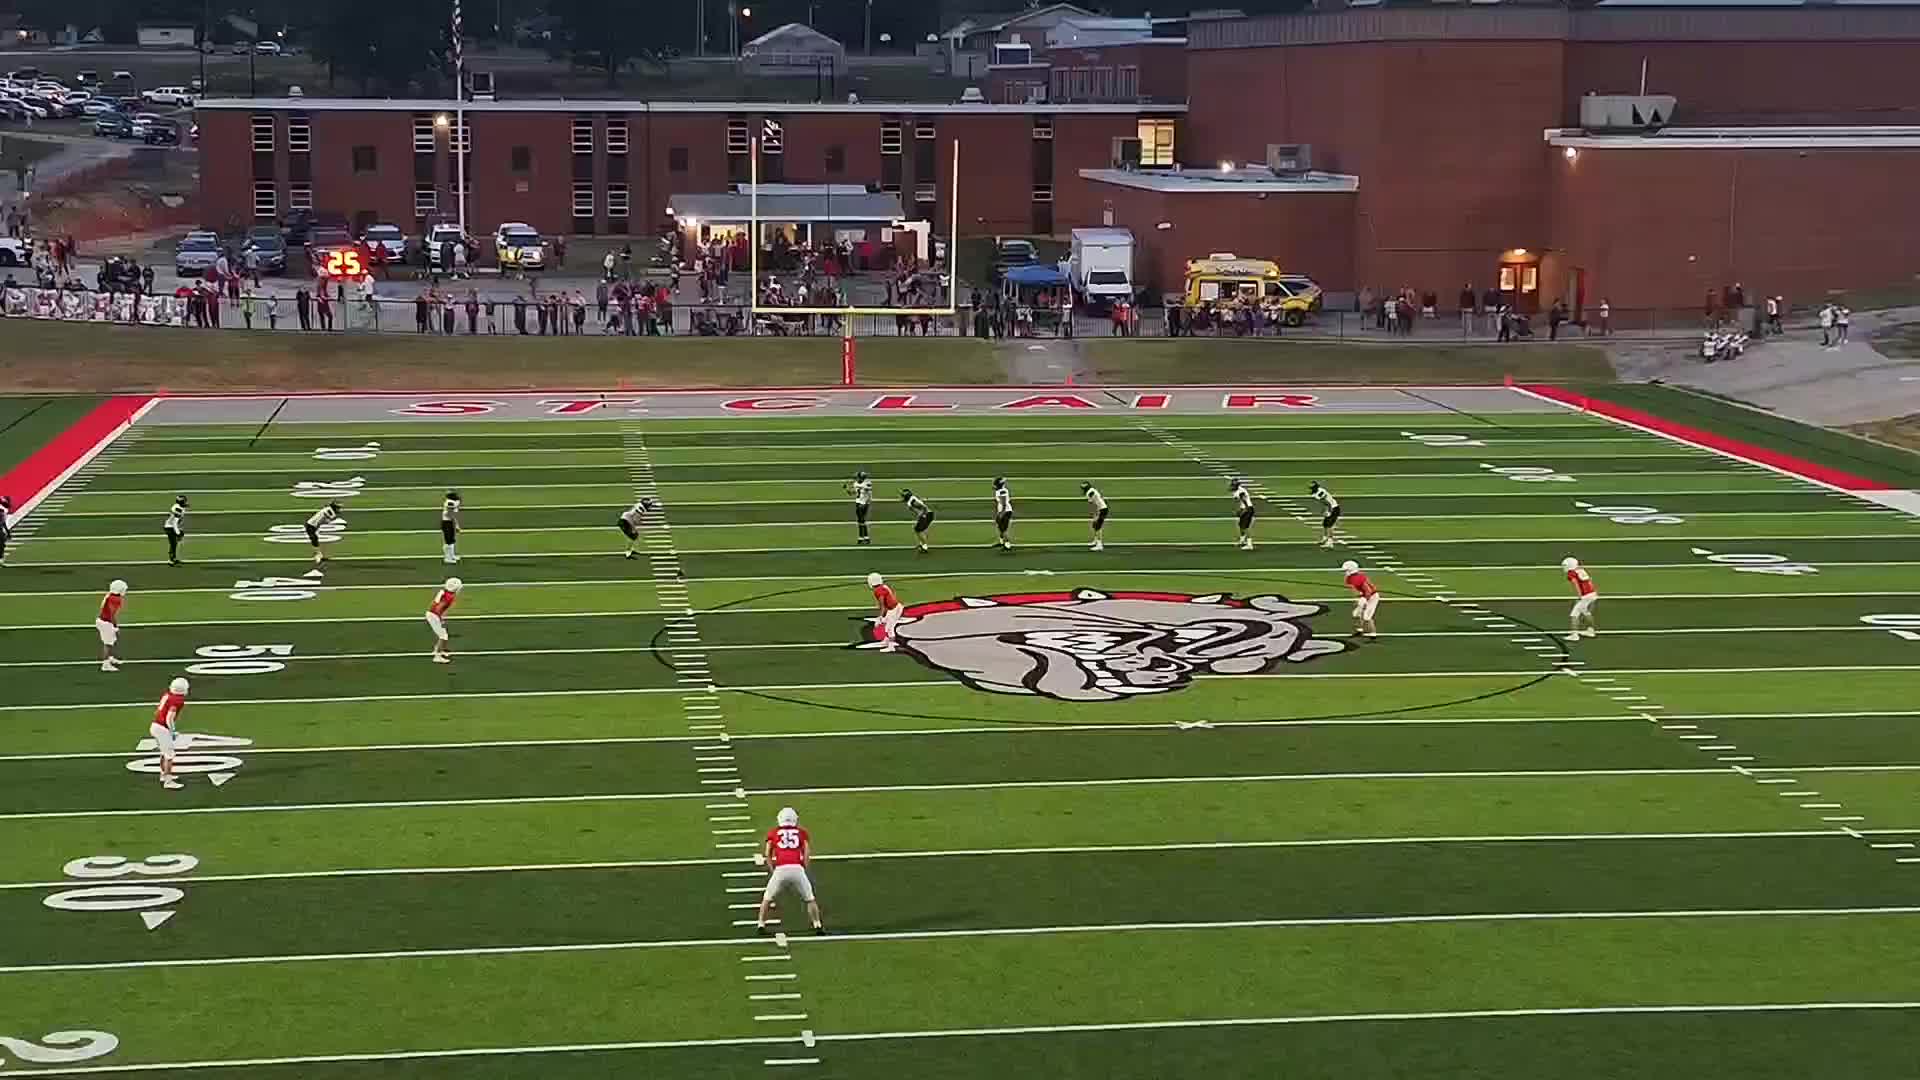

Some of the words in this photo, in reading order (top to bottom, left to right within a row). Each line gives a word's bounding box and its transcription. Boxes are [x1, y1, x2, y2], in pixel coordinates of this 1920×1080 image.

[328, 251, 361, 275] 25
[392, 399, 643, 416] ST
[720, 394, 1325, 411] CLAIR
[1587, 506, 1686, 524] 30
[1707, 554, 1821, 576] 40
[229, 576, 322, 601] 40
[184, 644, 295, 675] 50
[126, 734, 253, 773] 40
[776, 828, 800, 849] 35
[42, 854, 199, 910] 30
